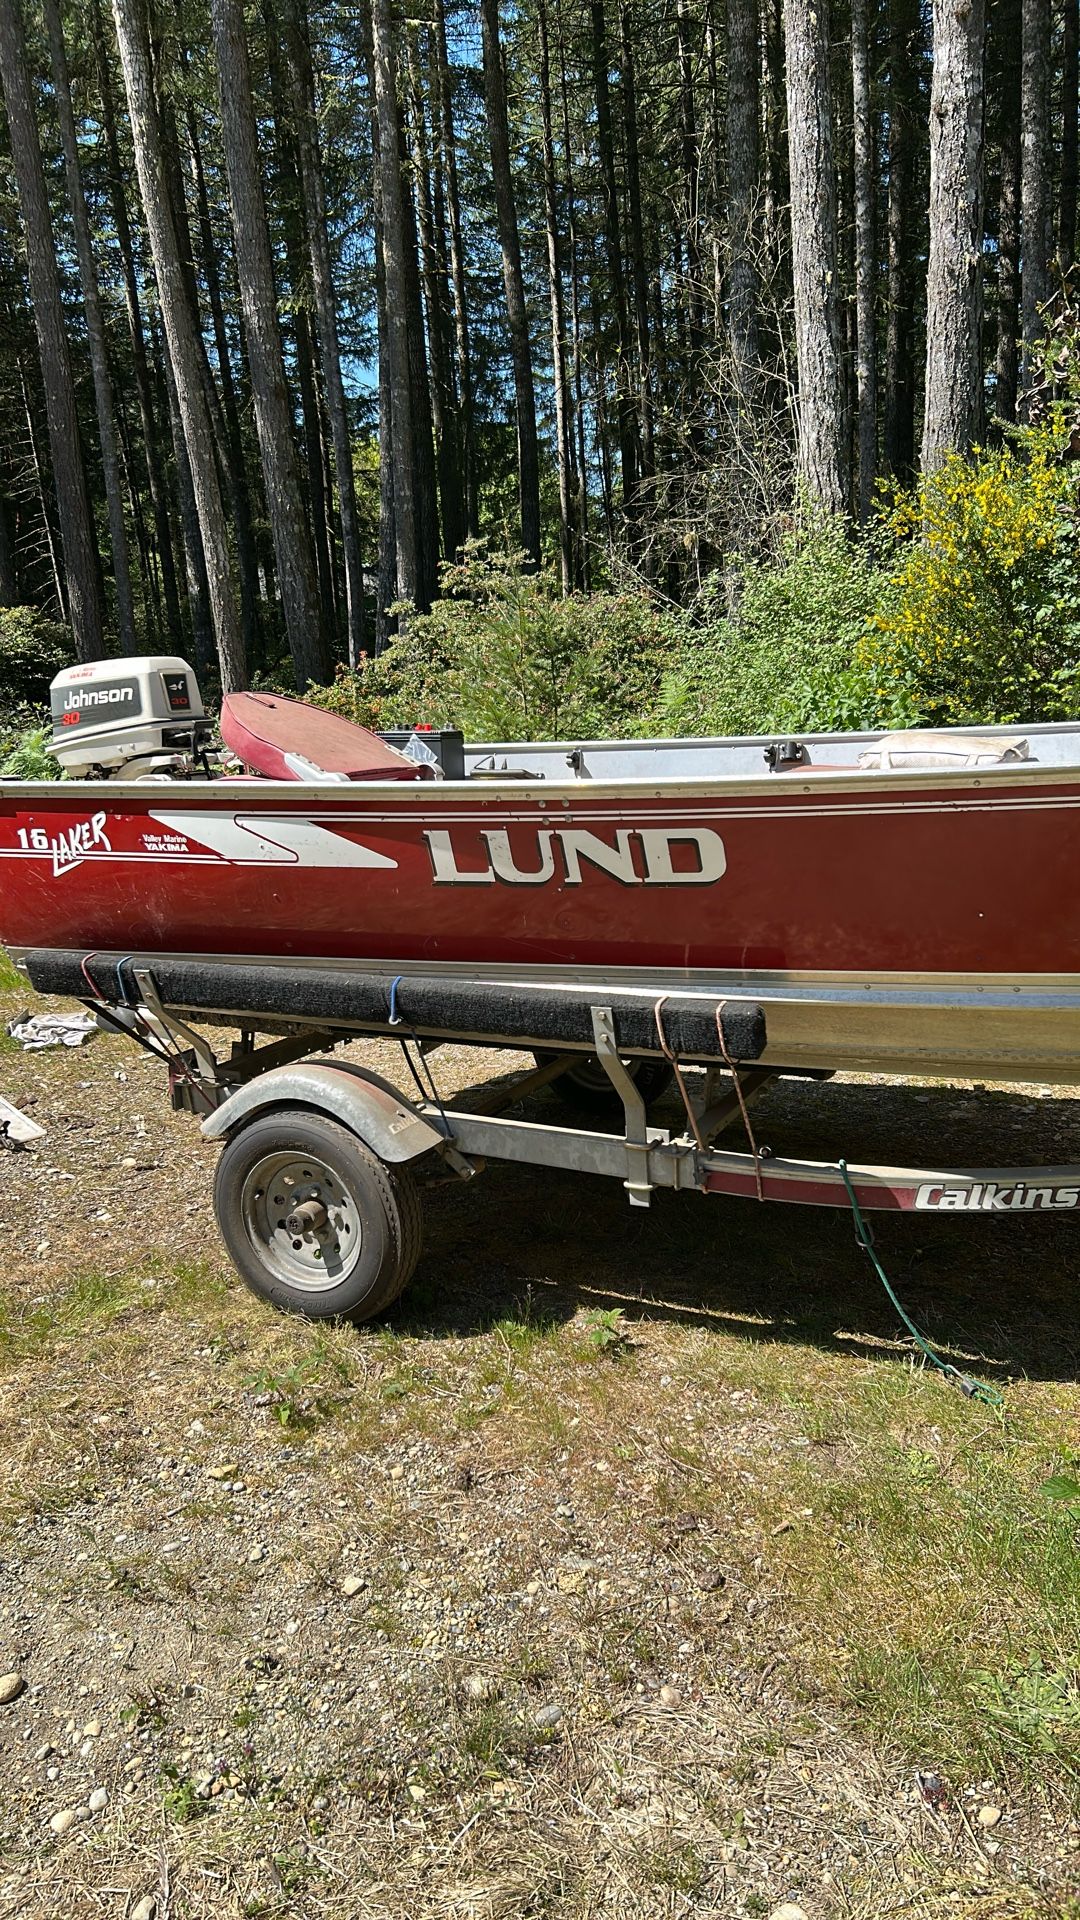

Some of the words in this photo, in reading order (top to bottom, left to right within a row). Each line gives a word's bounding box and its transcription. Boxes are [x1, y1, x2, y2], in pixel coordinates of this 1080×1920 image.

[64, 687, 134, 710] Johnson
[61, 711, 80, 726] 30
[17, 828, 48, 849] 16
[52, 811, 112, 877] LAKER
[142, 834, 161, 843] Valley
[163, 834, 188, 843] Marine
[144, 842, 189, 851] YAKIMA
[422, 828, 727, 885] LUND
[915, 1183, 1080, 1210] Calkins
